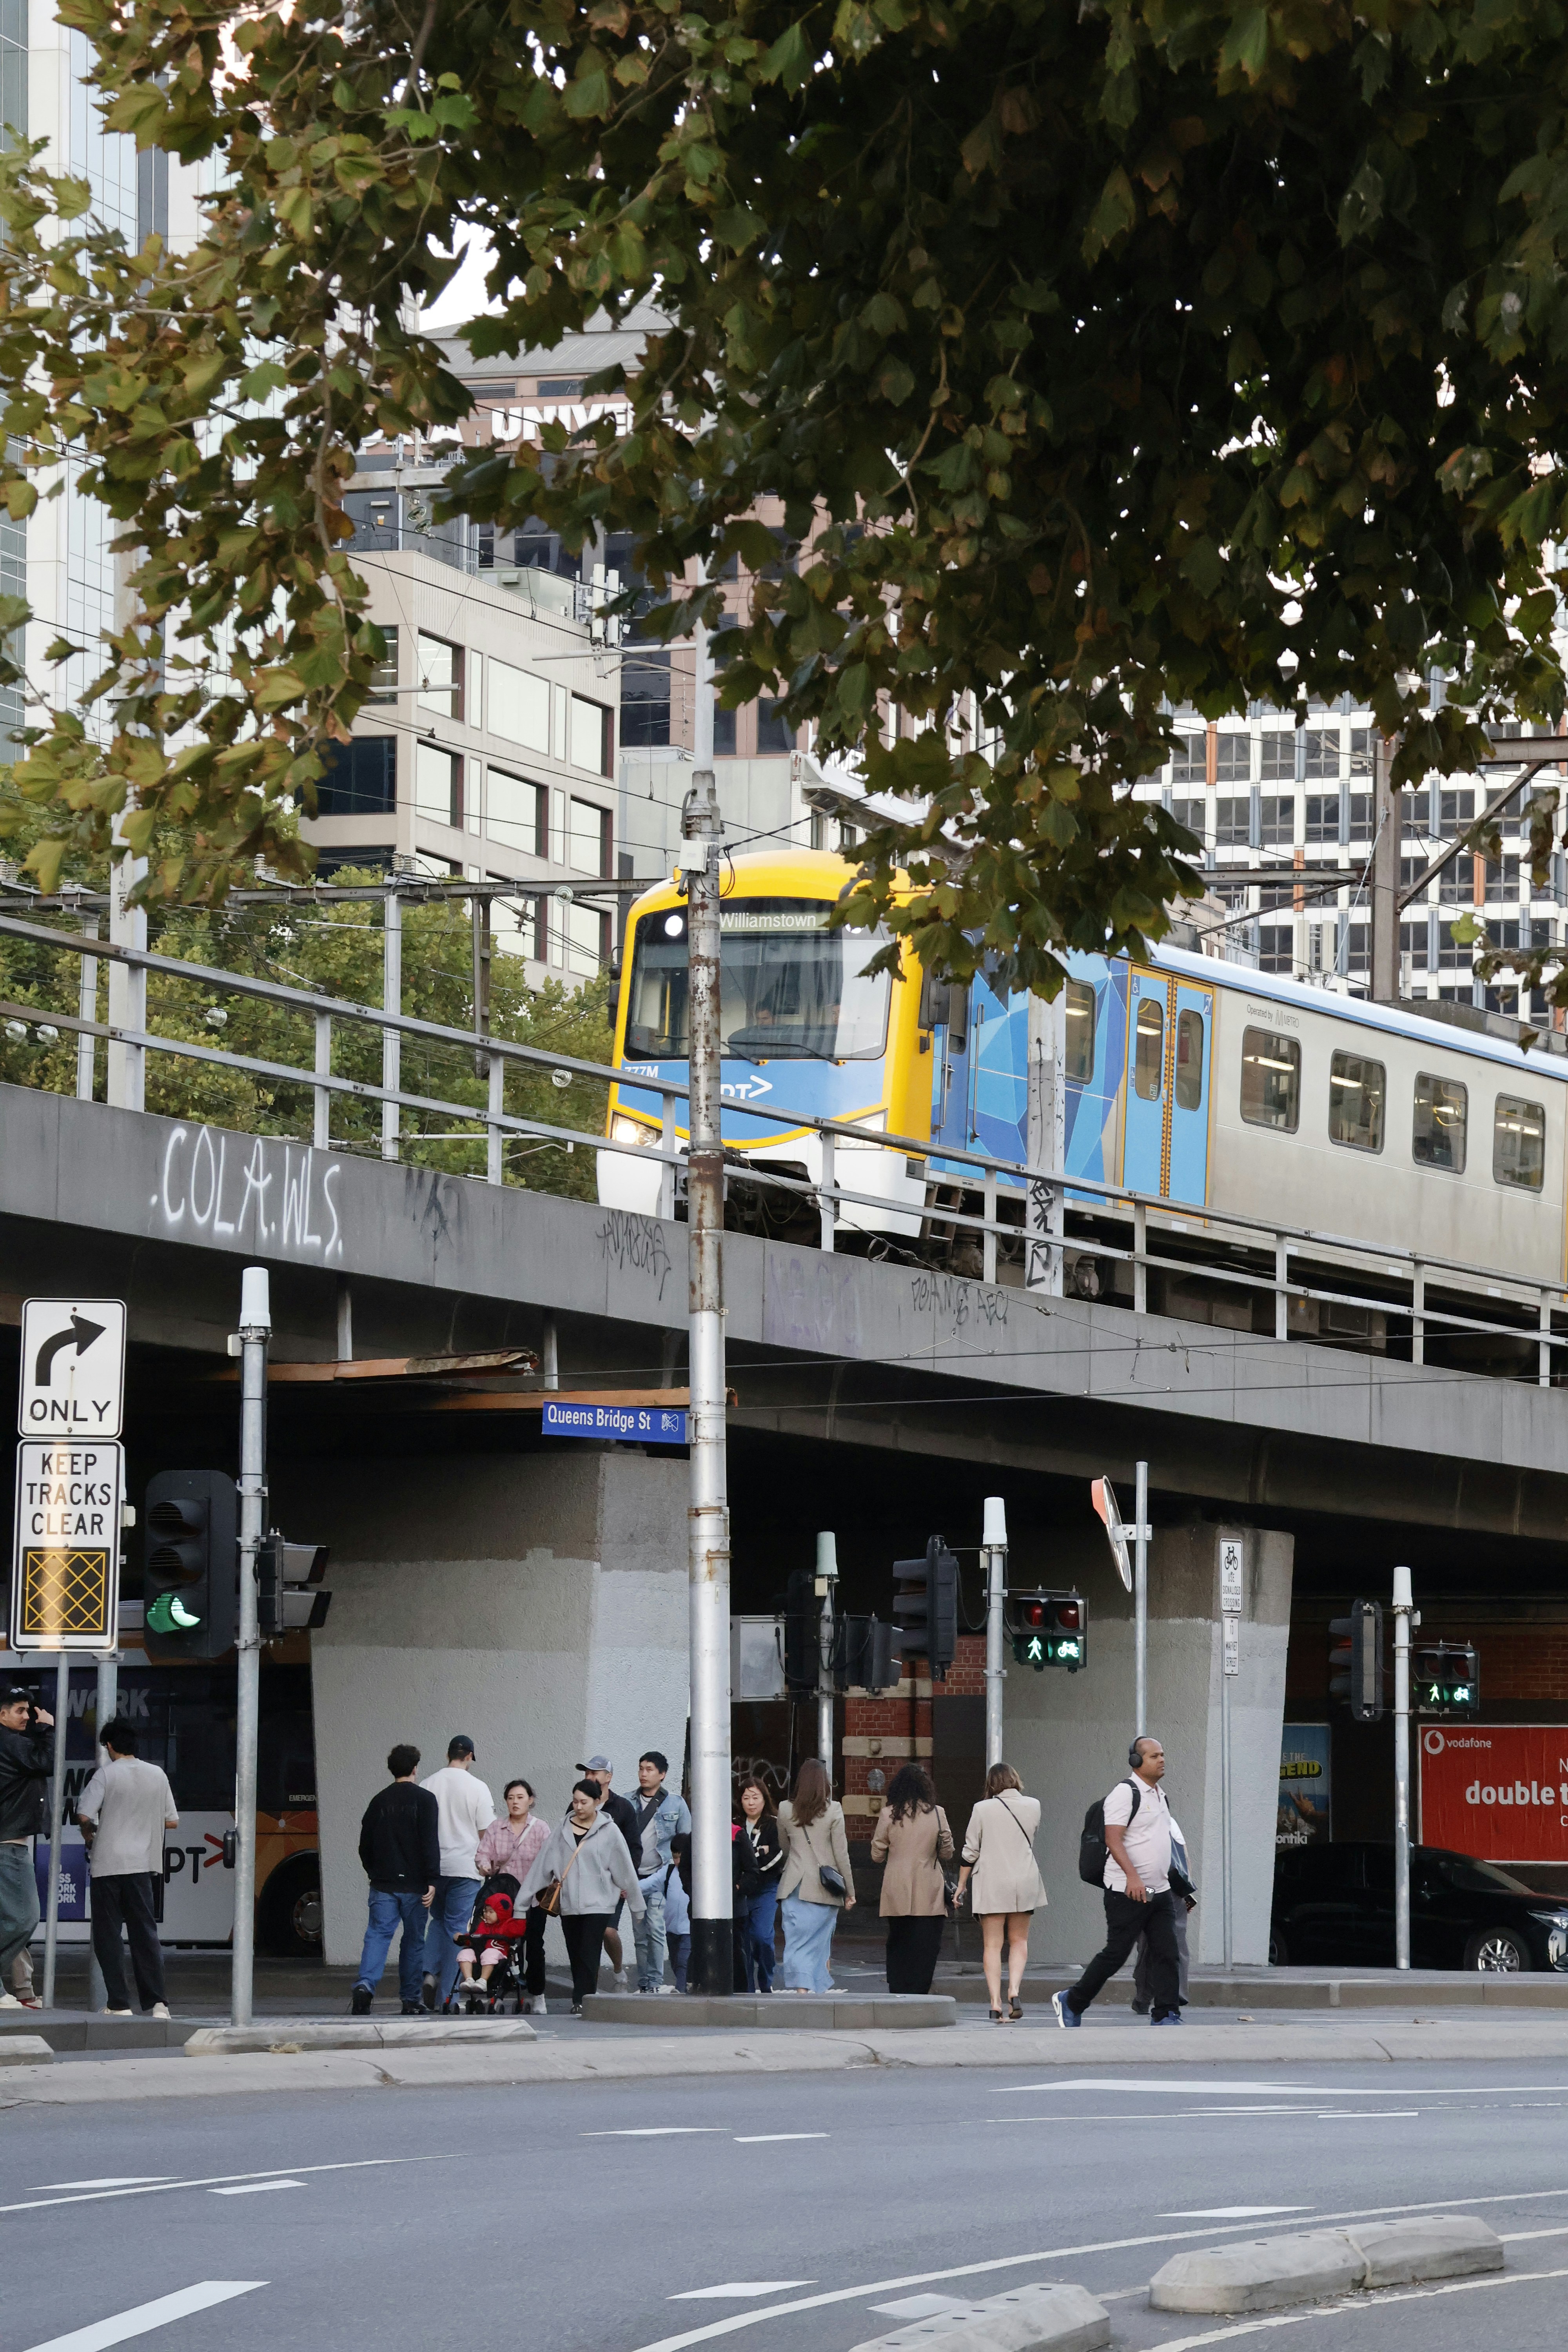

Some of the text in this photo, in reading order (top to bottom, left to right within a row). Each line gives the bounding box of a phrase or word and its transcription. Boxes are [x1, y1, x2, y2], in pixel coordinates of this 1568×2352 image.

[720, 912, 816, 929] Williamstown
[1247, 1004, 1267, 1018] Operated
[1268, 1009, 1273, 1022] by
[30, 1399, 111, 1422] ONLY
[548, 1405, 651, 1432] Queens Bridge St
[42, 1453, 97, 1475] KEEP
[26, 1483, 111, 1505] TRACKS
[31, 1512, 103, 1535] CLEAR
[1223, 1586, 1241, 1595] SIGNALISED
[1223, 1598, 1240, 1607] CROSSING
[1230, 1625, 1234, 1635] TO
[1225, 1641, 1238, 1651] MARKET
[1226, 1657, 1237, 1667] STREET
[1446, 1738, 1492, 1748] vodafone
[1279, 1761, 1319, 1777] GEND
[1466, 1780, 1555, 1805] double
[1276, 1831, 1308, 1844] ontiki
[59, 1883, 76, 1893] ORK
[58, 1893, 76, 1903] ORK
